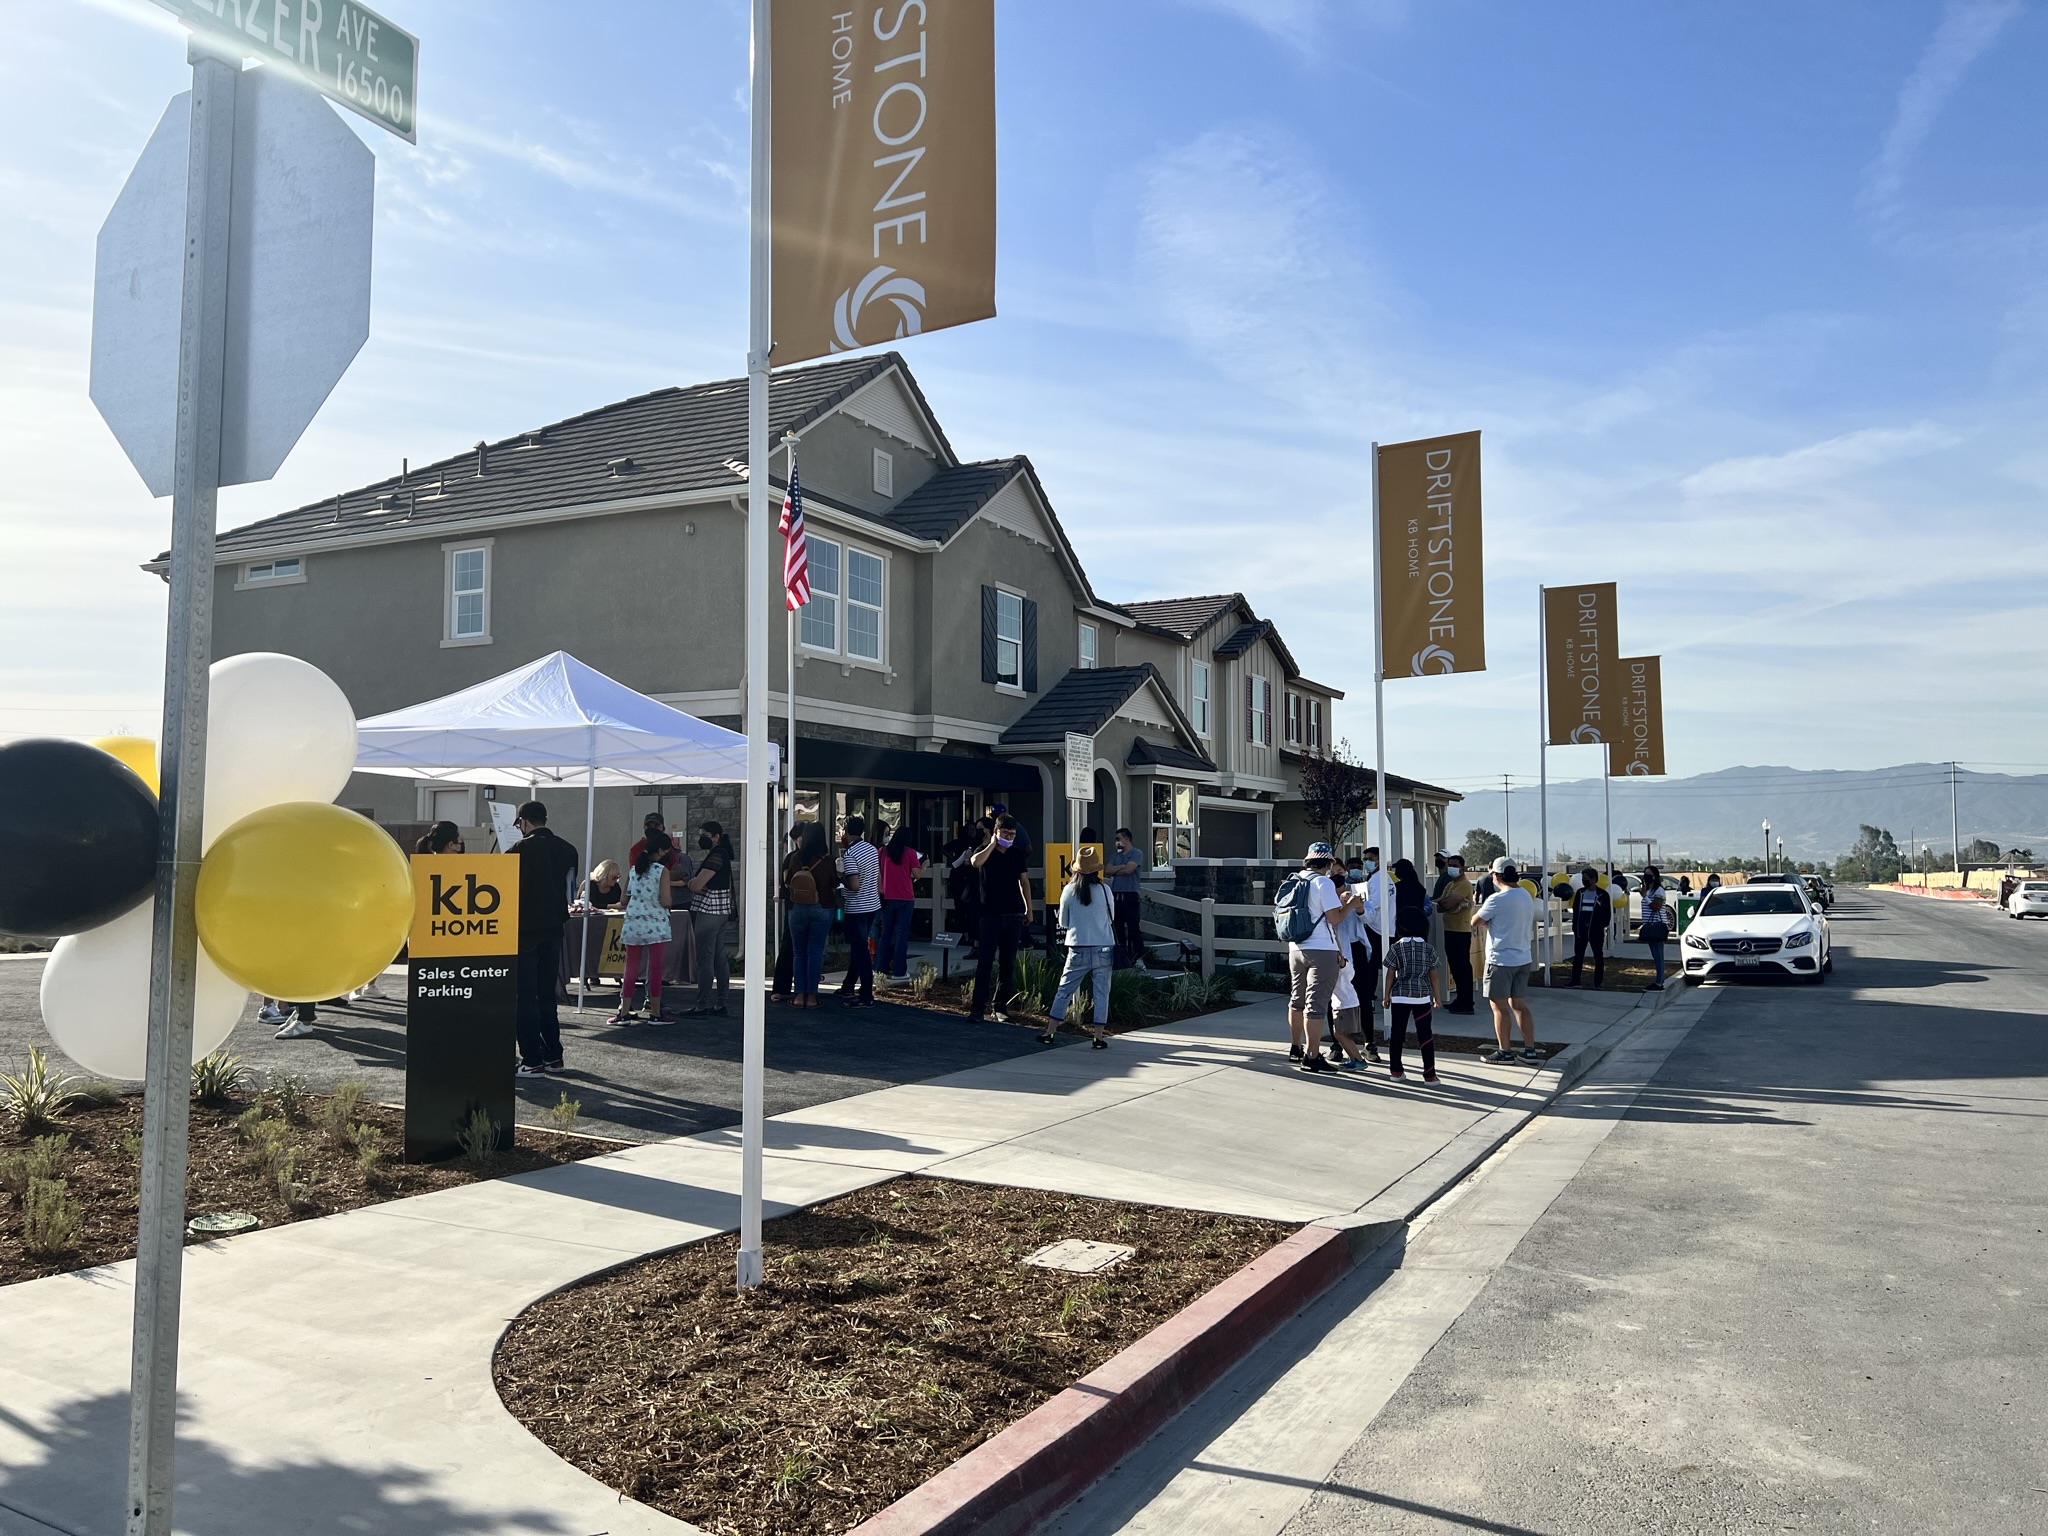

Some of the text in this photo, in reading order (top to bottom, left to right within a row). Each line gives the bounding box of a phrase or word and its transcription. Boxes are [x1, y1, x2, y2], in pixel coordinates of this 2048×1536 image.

[192, 0, 321, 73] ZER
[336, 4, 380, 63] AVE
[832, 11, 853, 110] HOME
[336, 53, 403, 124] 16500
[1407, 518, 1419, 579] KB HOME
[1426, 449, 1455, 641] DRIFTSTONE
[1566, 638, 1575, 678] KB HOME
[1578, 593, 1601, 722] DRIFTSTONE
[1622, 707, 1630, 727] HOME
[1631, 663, 1649, 760] DRIFTSTONE
[430, 874, 501, 915] kb
[431, 919, 499, 936] HOME
[609, 929, 626, 952] k
[418, 966, 510, 980] Sales Center
[607, 953, 627, 963] HOM
[418, 985, 473, 999] Parking
